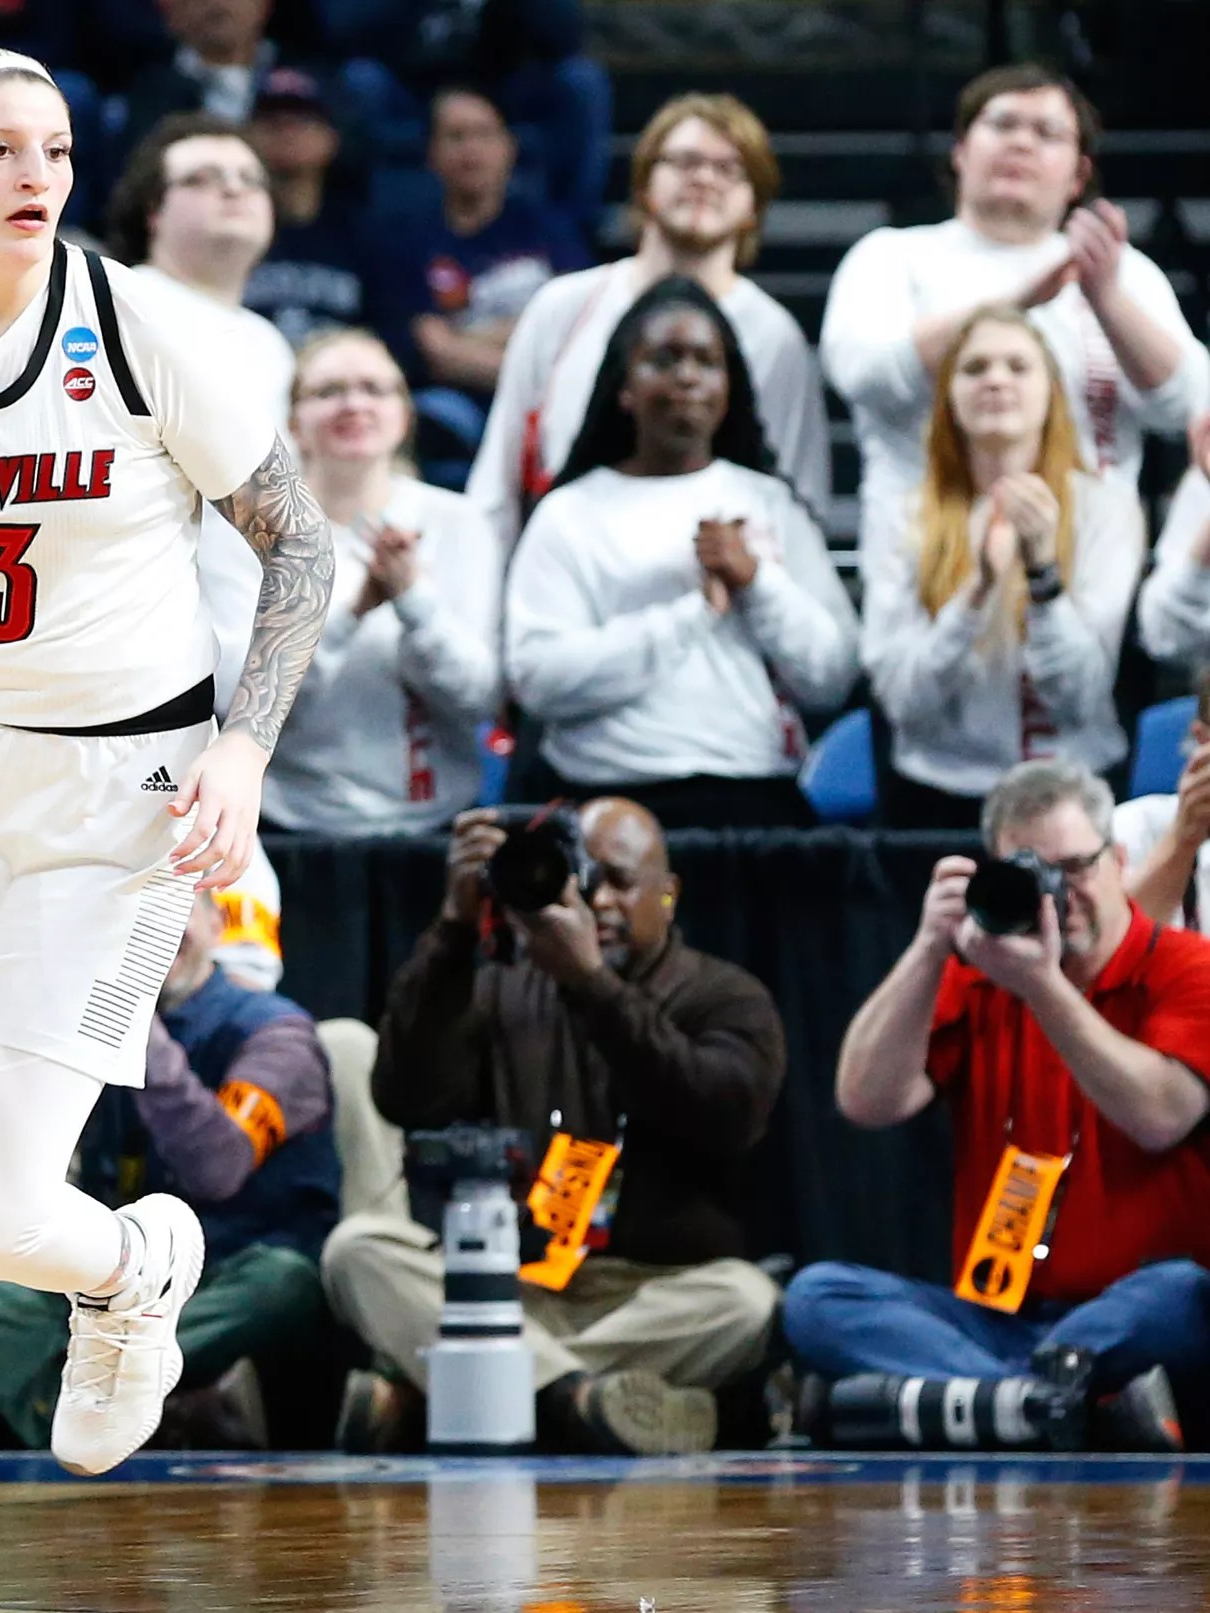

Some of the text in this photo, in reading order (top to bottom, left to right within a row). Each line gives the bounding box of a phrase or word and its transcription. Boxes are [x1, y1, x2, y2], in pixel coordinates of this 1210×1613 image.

[67, 341, 97, 353] NCAA
[64, 377, 94, 389] ACC
[140, 782, 178, 792] adidas
